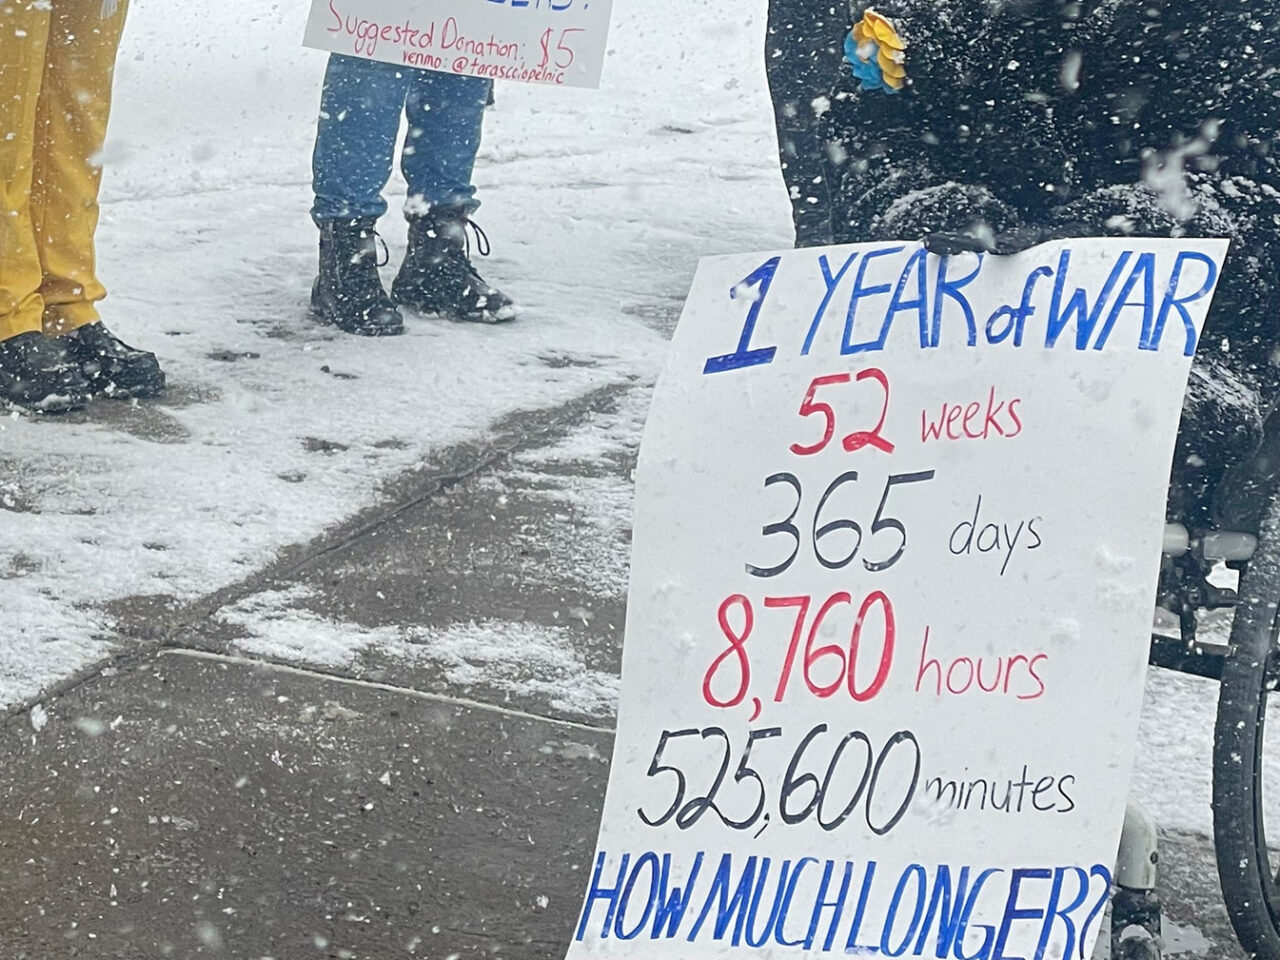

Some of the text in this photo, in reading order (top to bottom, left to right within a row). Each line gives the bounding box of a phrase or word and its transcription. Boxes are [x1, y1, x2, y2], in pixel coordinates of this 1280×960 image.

[538, 26, 587, 69] $5
[702, 255, 781, 375] 1
[800, 245, 986, 357] YEAR
[1044, 249, 1218, 357] WAR
[789, 367, 1023, 457] 52 weeks
[745, 470, 1042, 578] 365 days
[702, 590, 1049, 723] 8,760 hours
[636, 722, 1076, 839] 525,600 minutes
[575, 851, 1113, 960] HOW MUCH LONGER?
